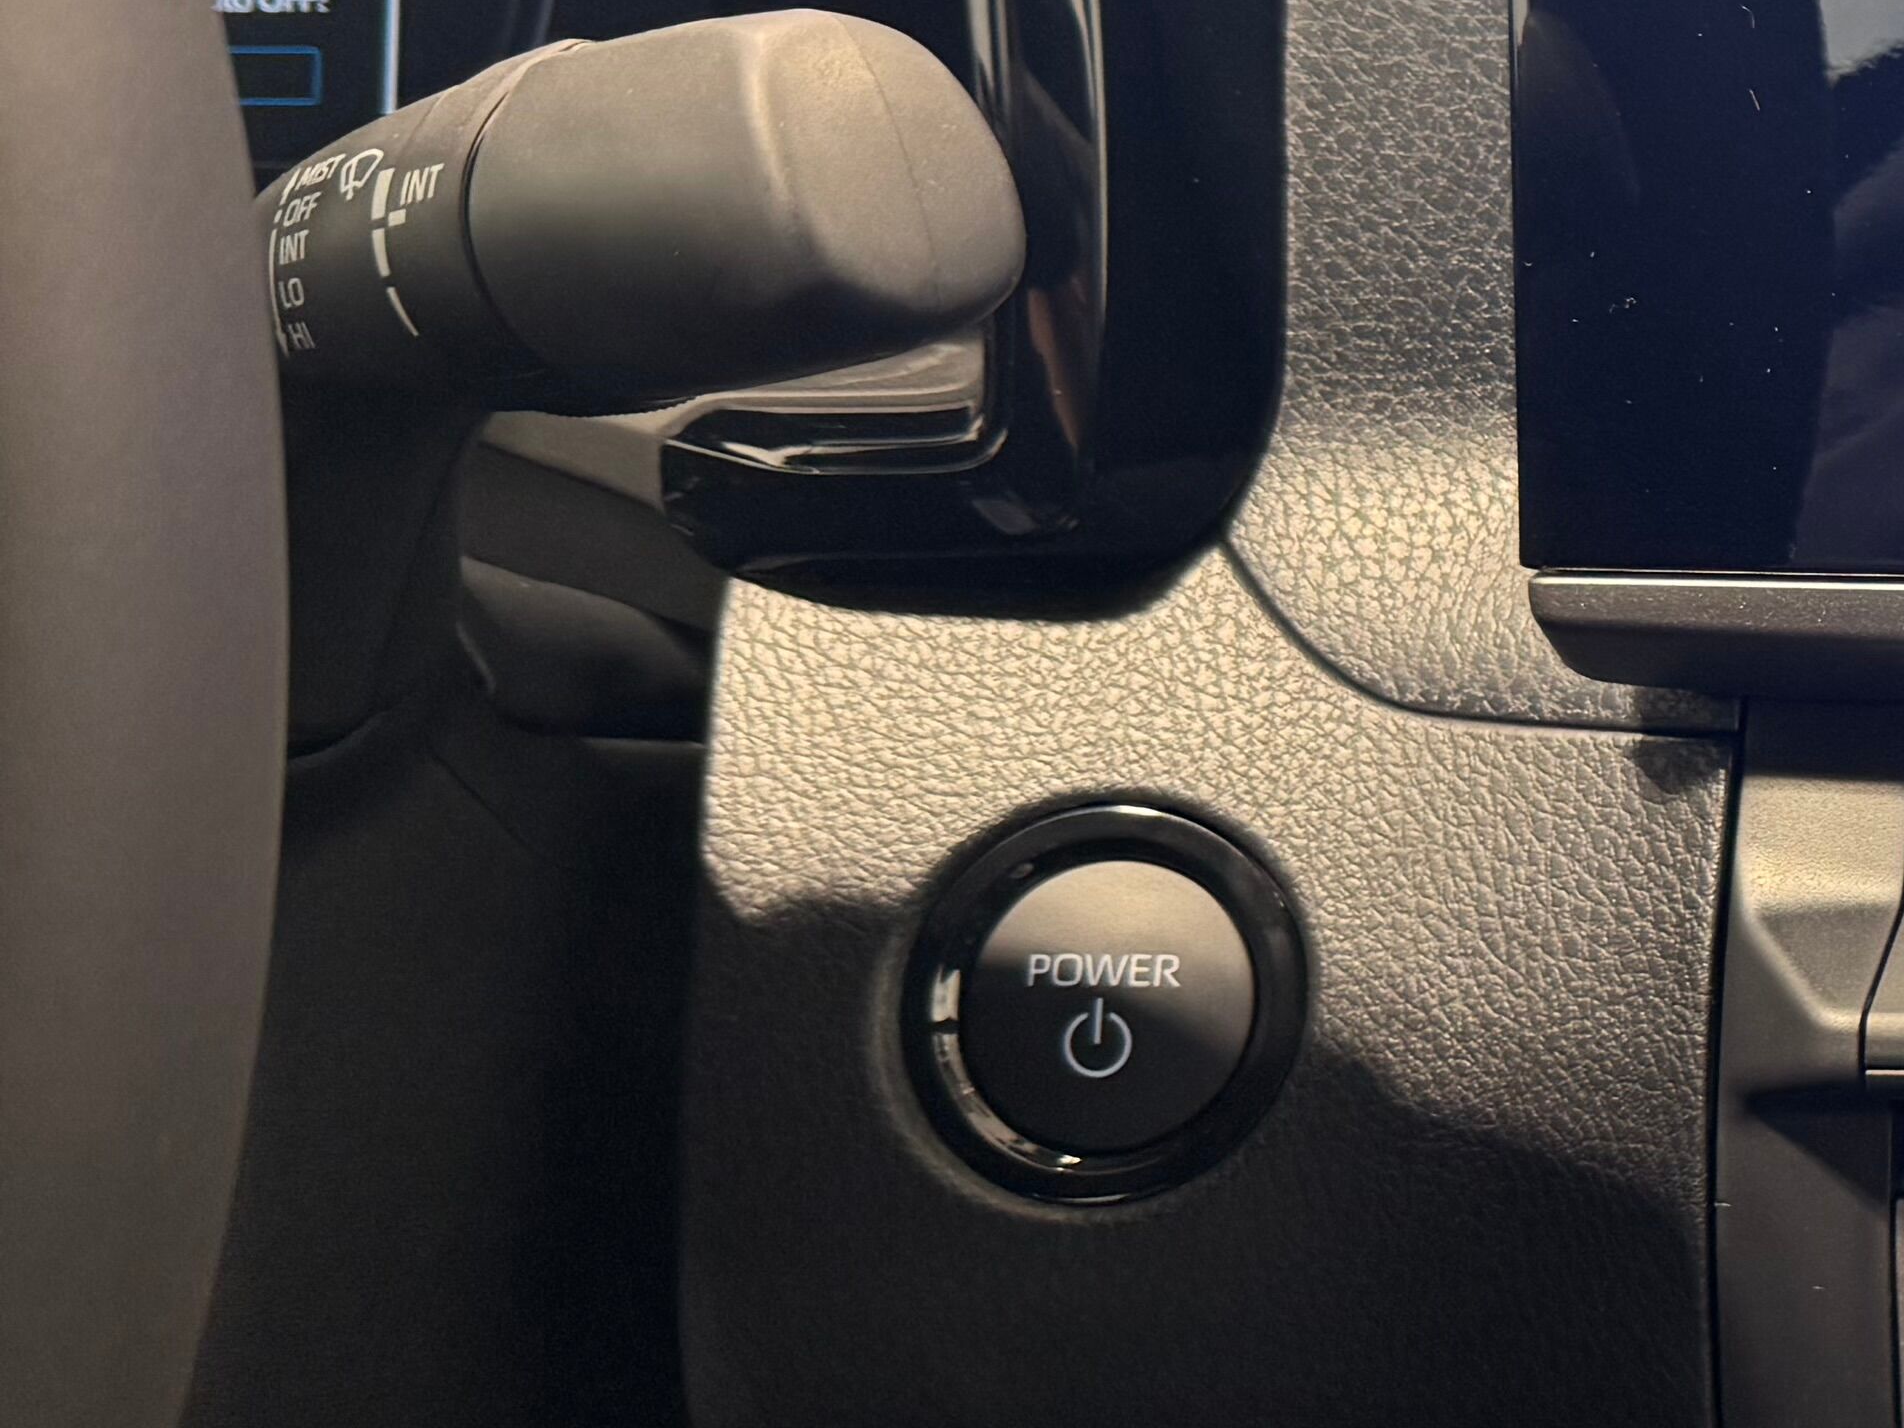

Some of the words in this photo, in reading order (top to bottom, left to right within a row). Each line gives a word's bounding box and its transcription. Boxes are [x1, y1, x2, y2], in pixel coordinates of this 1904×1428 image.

[295, 153, 347, 191] MIST
[399, 163, 445, 207] INT
[282, 191, 323, 228] OFF
[278, 229, 310, 266] INT
[277, 276, 306, 311] LO
[287, 321, 318, 351] HI
[1026, 952, 1182, 988] POWER
